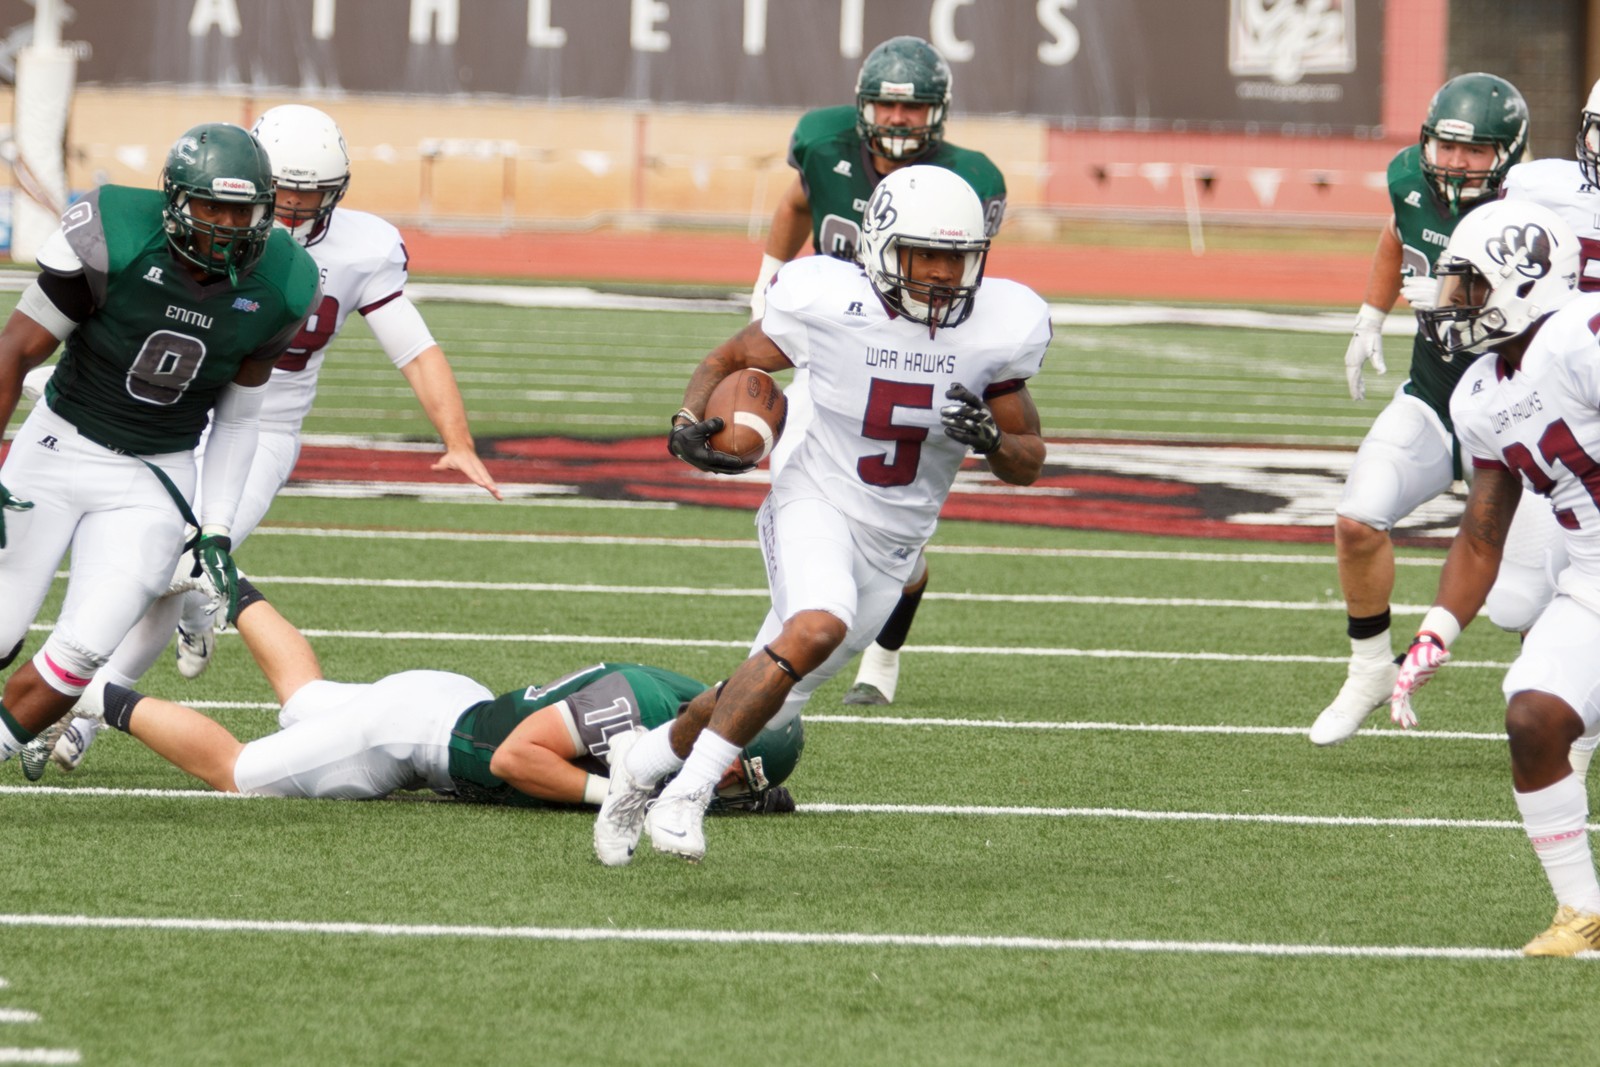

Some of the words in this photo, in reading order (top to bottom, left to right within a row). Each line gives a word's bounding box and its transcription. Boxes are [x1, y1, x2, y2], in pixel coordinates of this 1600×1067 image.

[165, 304, 213, 329] ENMU
[866, 346, 898, 371] WAR
[904, 352, 956, 374] HAWKS
[1489, 410, 1513, 434] WAR
[1509, 390, 1543, 424] HAWKS
[857, 377, 935, 487] 5
